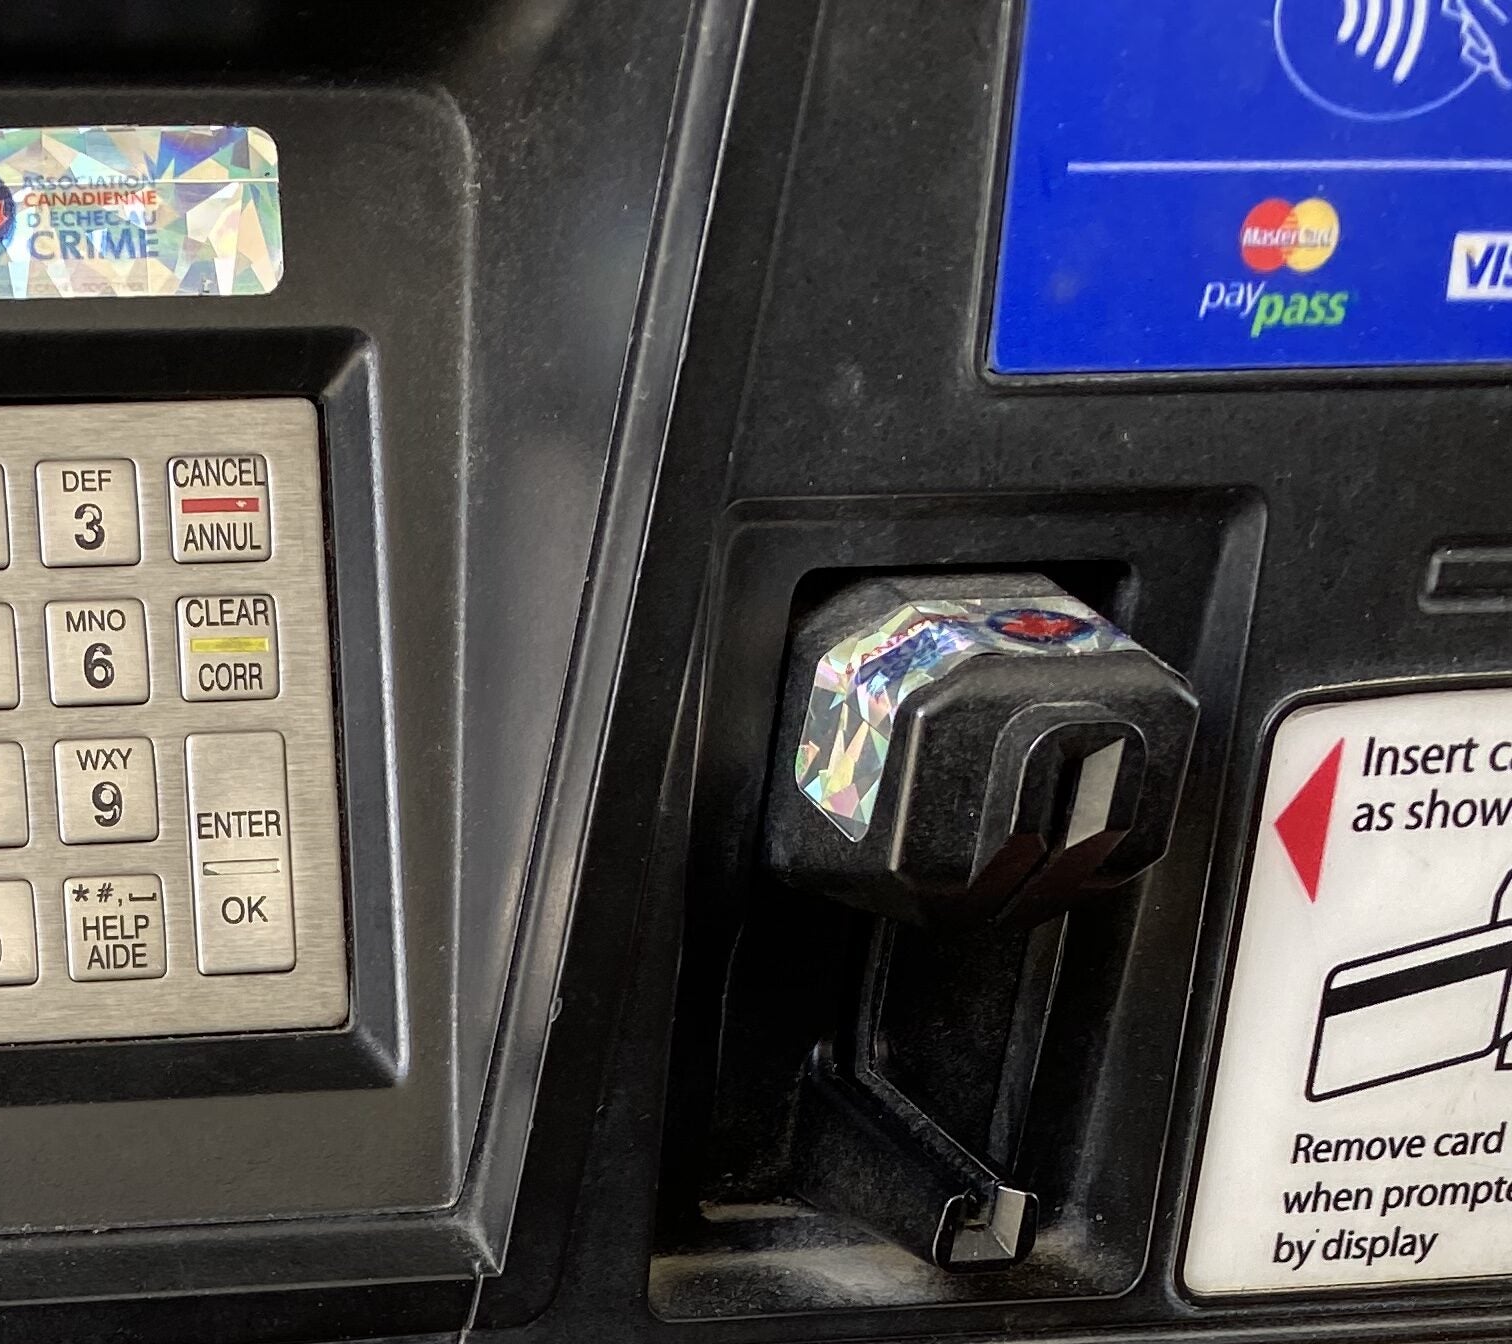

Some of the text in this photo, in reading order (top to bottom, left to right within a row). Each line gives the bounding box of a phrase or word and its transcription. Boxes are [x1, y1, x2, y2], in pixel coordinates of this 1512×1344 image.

[23, 175, 157, 190] ASSOCIATION
[24, 191, 157, 207] CANADIENNE
[29, 229, 159, 260] CRIME
[62, 470, 112, 493] DEF
[172, 458, 266, 488] CANCEL
[74, 503, 106, 551] 3
[183, 522, 262, 552] ANNUL
[66, 610, 126, 632] MNO
[185, 599, 270, 627] CLEAR
[84, 643, 115, 690] 6
[198, 662, 264, 691] CORR
[76, 748, 133, 771] WXY
[1362, 736, 1480, 777] Insert
[91, 781, 124, 828] 9
[1352, 788, 1512, 832] as show
[198, 811, 282, 840] ENTER
[221, 896, 268, 924] OK
[82, 914, 150, 942] HELP
[86, 942, 148, 971] AIDE
[1290, 1121, 1507, 1164] Remove card
[1283, 1181, 1373, 1214] when
[1272, 1226, 1439, 1271] by display
